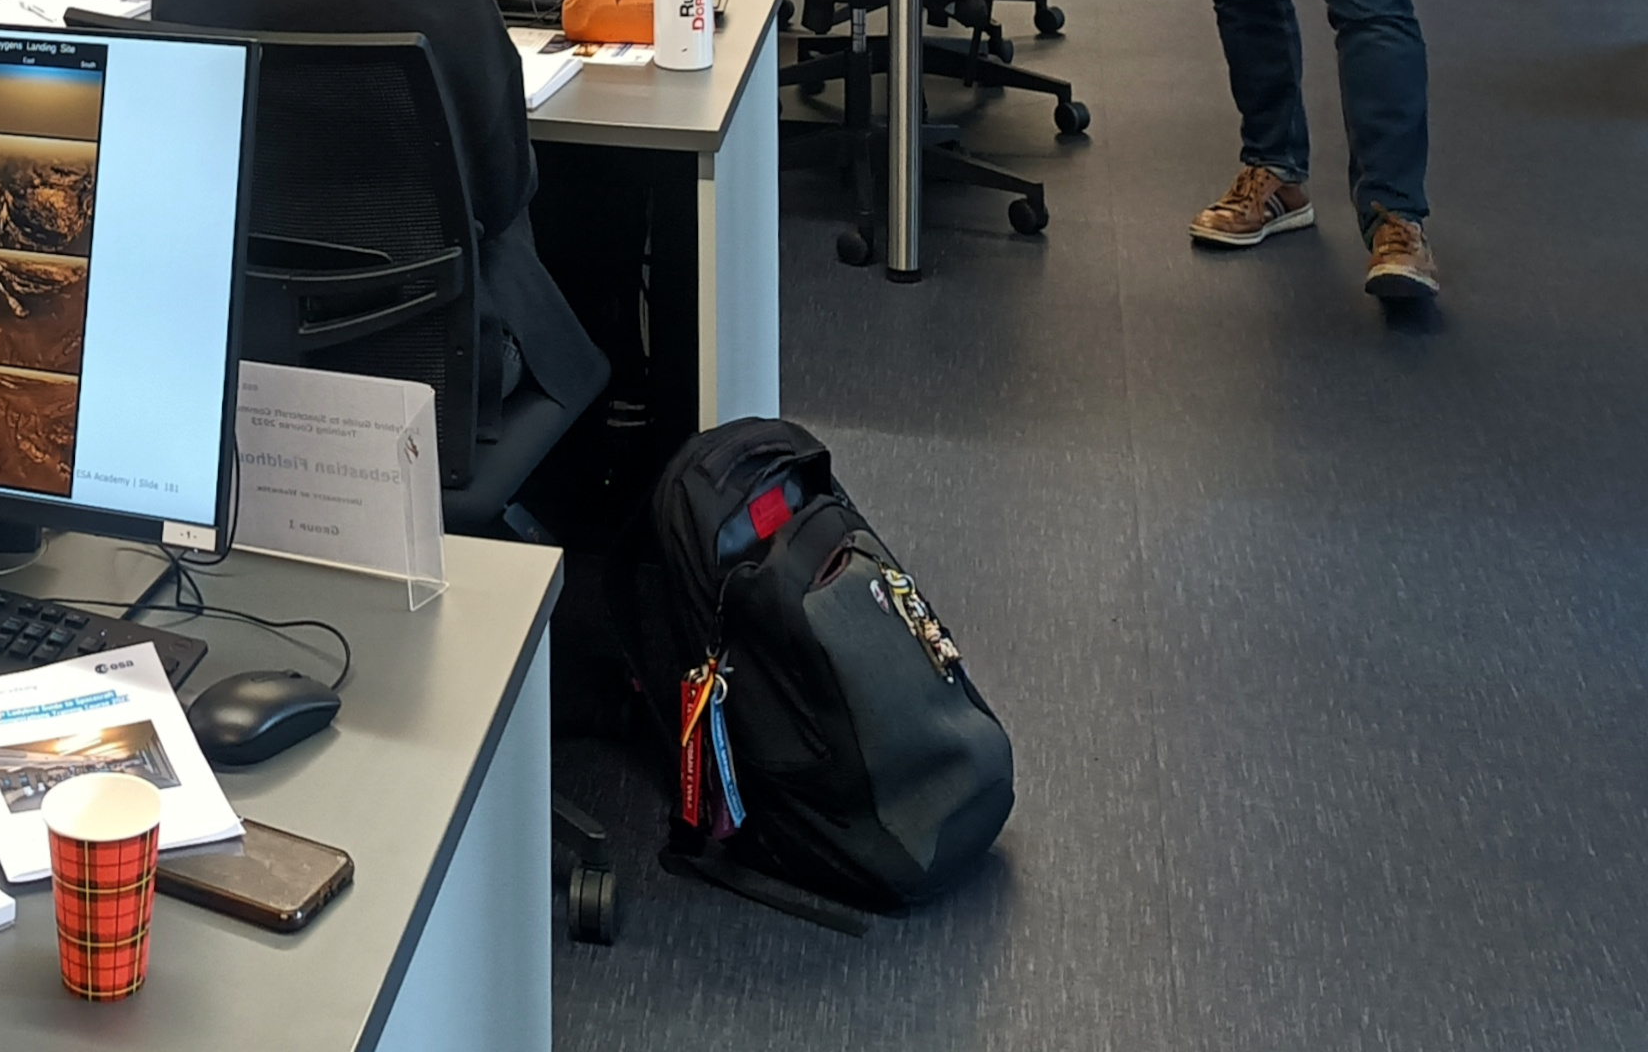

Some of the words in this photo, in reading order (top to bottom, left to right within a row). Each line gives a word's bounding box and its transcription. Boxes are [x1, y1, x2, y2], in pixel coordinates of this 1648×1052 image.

[26, 41, 57, 55] Landing
[60, 43, 76, 54] Site
[76, 469, 92, 479] ESA
[94, 473, 130, 487] Academy
[139, 478, 159, 490] Slide
[164, 482, 179, 493] 181
